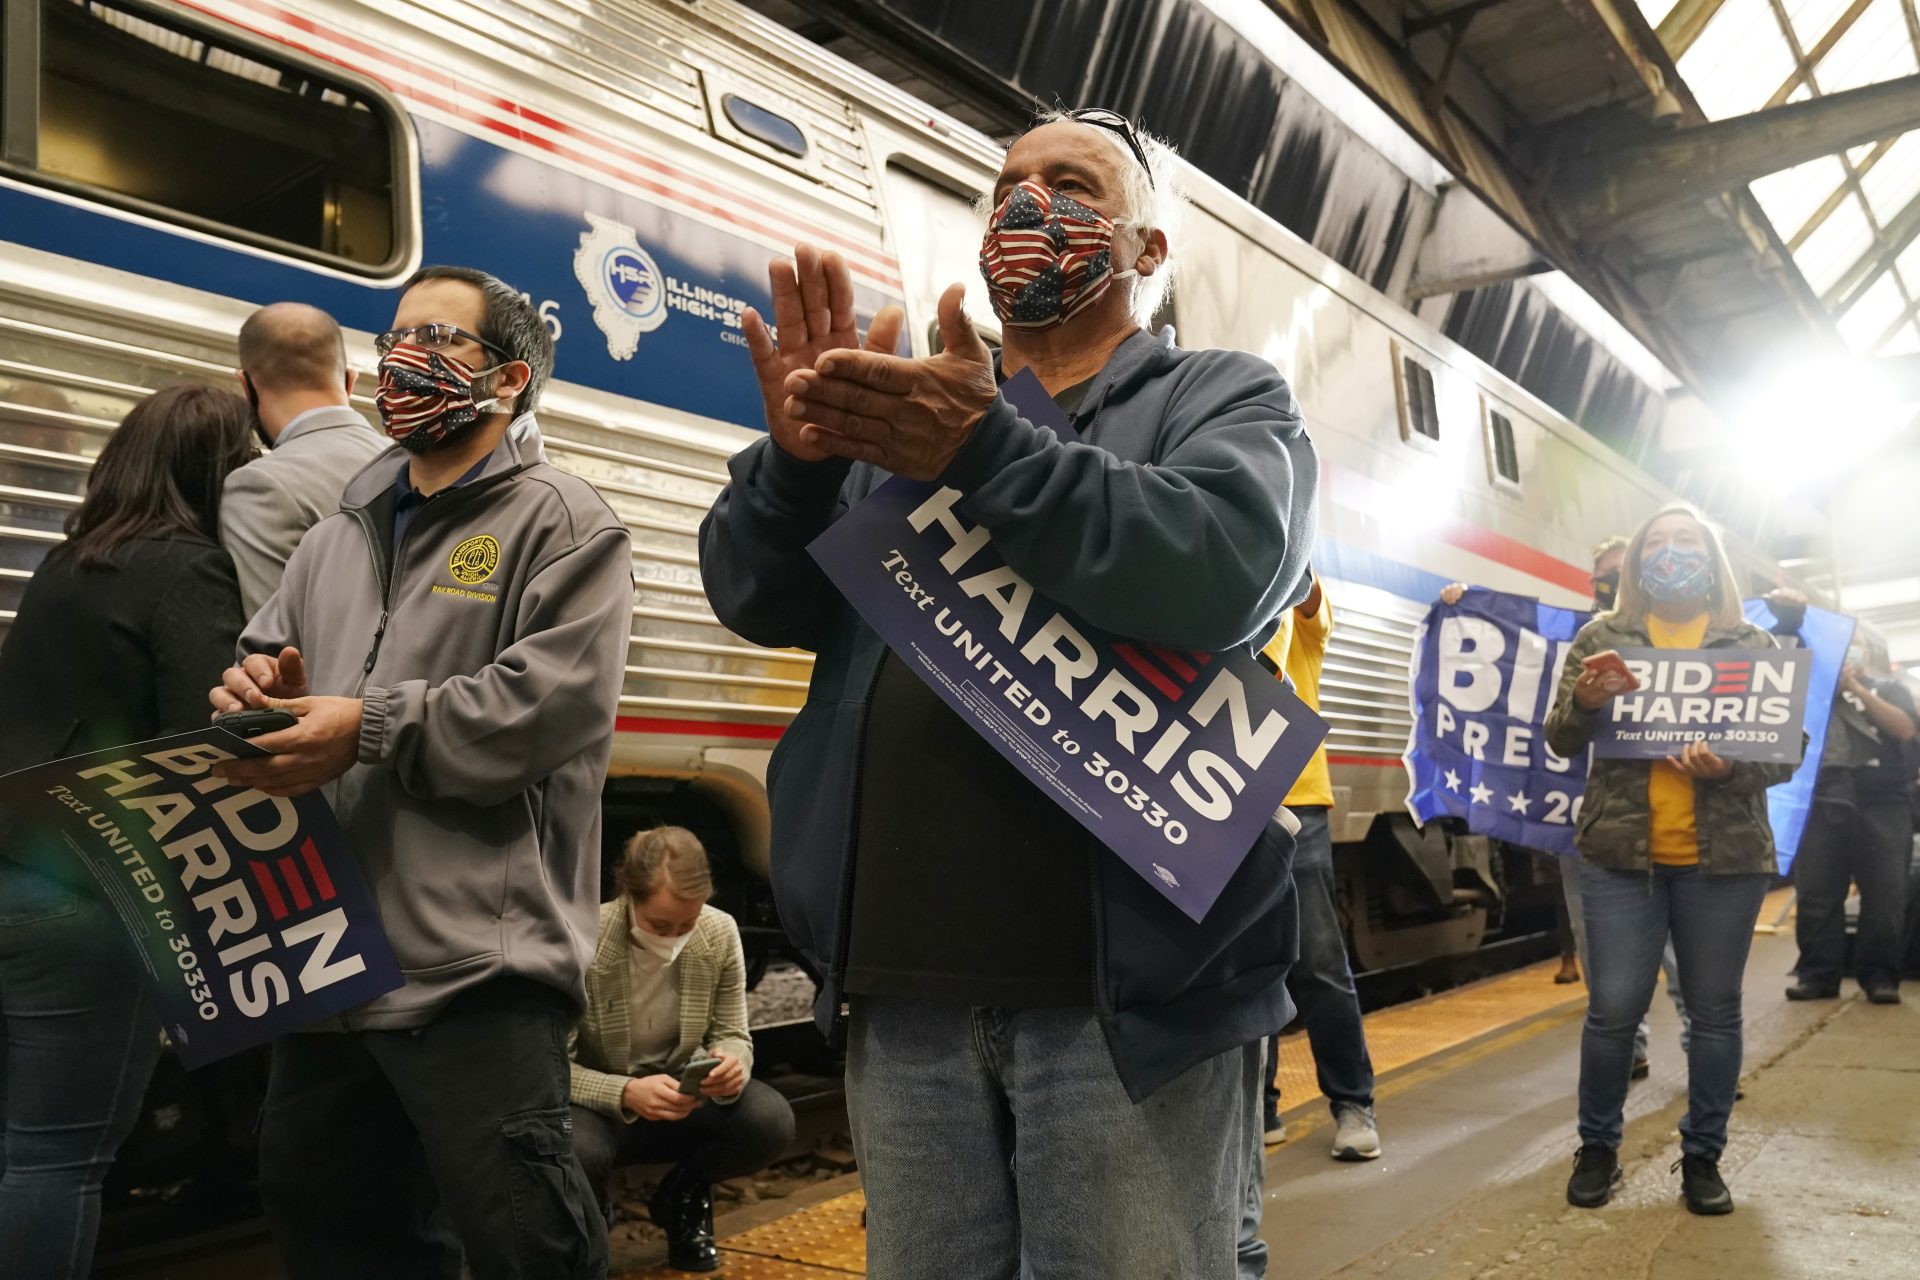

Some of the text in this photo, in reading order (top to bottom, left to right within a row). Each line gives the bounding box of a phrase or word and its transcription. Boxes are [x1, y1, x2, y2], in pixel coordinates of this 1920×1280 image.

[666, 276, 747, 315] ILLINOIS
[720, 330, 749, 348] CHIC
[431, 584, 497, 602] RAILROAD DIVISION
[907, 484, 1246, 822] HARRIS
[881, 549, 1188, 846] Text UNITED to 30330
[1612, 695, 1791, 725] HARRIS
[1615, 730, 1779, 743] Text UNITED to 30330
[46, 785, 93, 815] Text
[88, 813, 165, 903] UNITED
[155, 908, 175, 931] to
[168, 933, 219, 1021] 30330
[75, 759, 290, 1018] HARRIS
[141, 743, 367, 995] BIDEN
